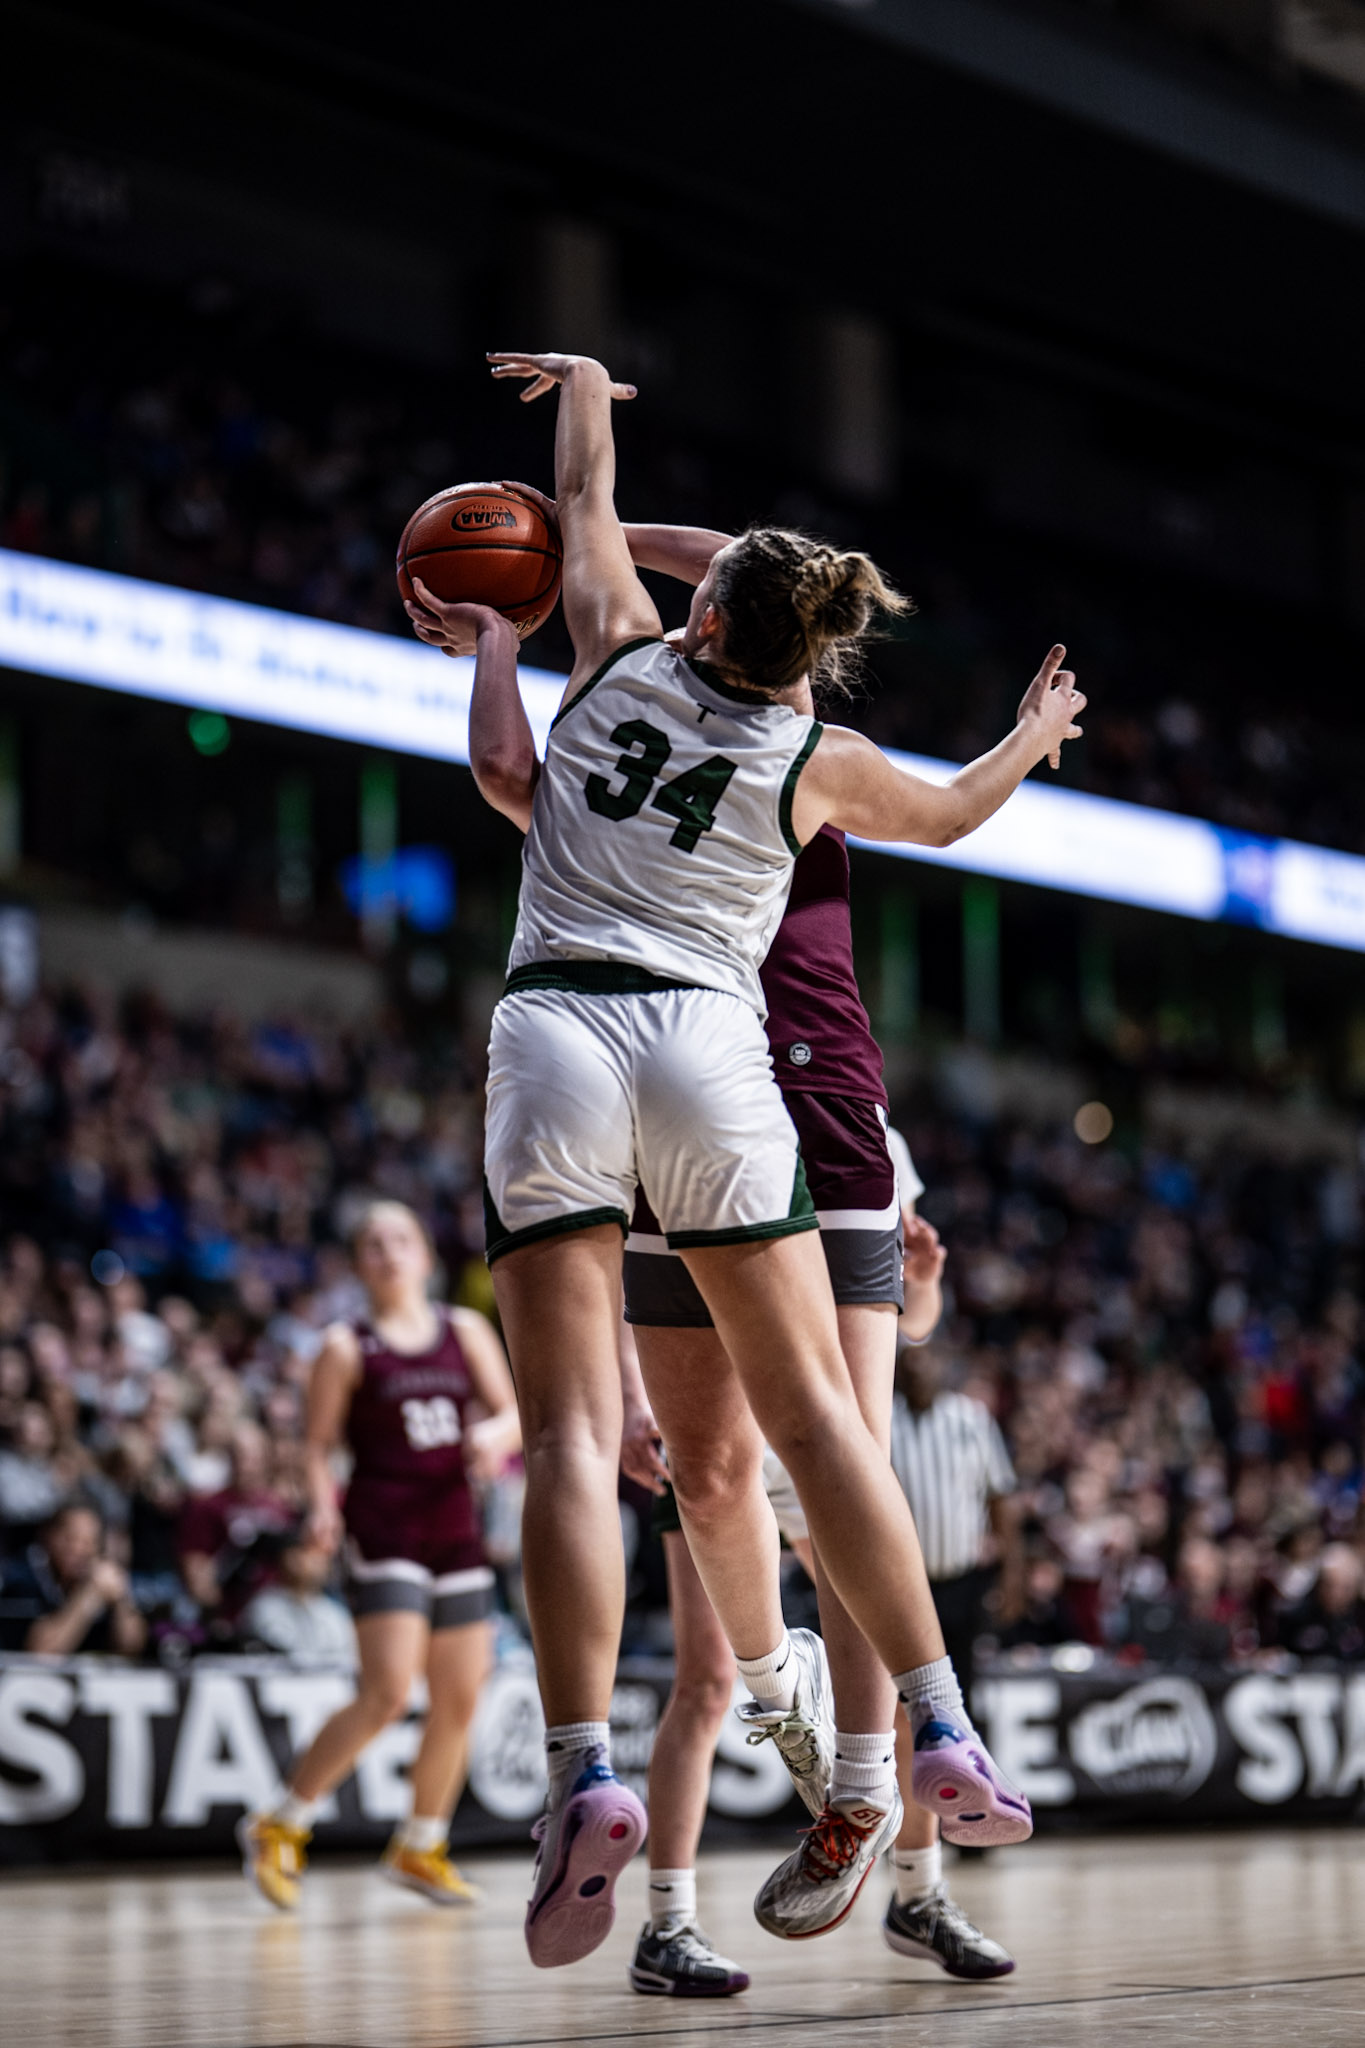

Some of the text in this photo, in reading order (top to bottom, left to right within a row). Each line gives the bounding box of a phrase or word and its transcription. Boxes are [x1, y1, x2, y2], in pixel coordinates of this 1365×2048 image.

[460, 511, 507, 525] WIAA
[697, 702, 717, 724] T
[584, 719, 738, 854] 34
